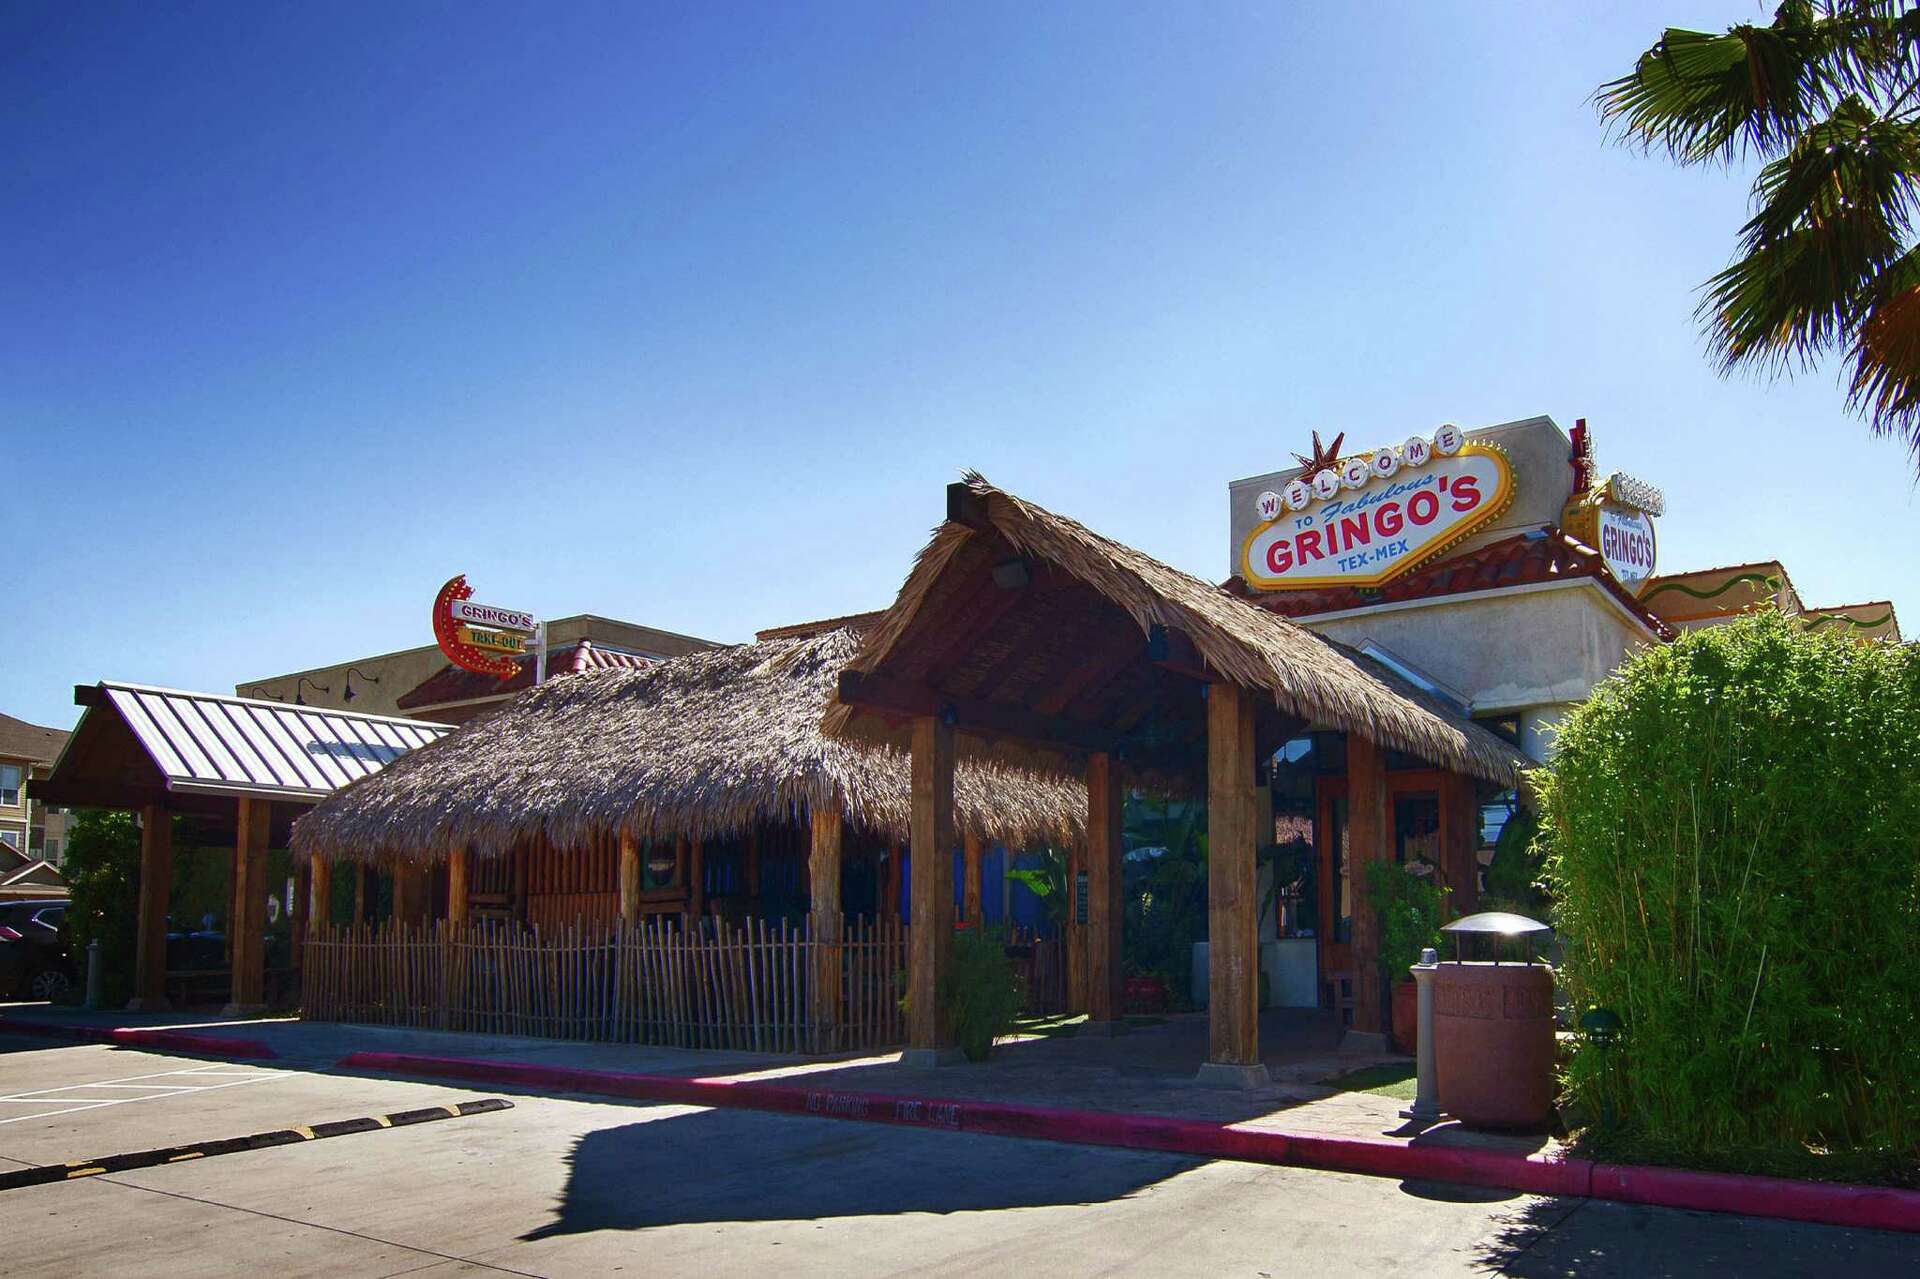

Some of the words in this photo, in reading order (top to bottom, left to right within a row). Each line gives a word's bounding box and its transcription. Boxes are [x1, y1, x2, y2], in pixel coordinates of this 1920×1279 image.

[1262, 430, 1455, 514] WELCOME
[1266, 475, 1481, 574] GRINGO'S
[1296, 515, 1313, 530] TO
[1320, 474, 1437, 523] Fabulous
[1338, 539, 1409, 572] TEX-MEX
[1603, 524, 1652, 569] GRINGO'S
[462, 605, 532, 627] GRINGO'S
[807, 1092, 821, 1112] NO
[896, 1101, 922, 1120] FIRE
[928, 1103, 961, 1125] LANE
